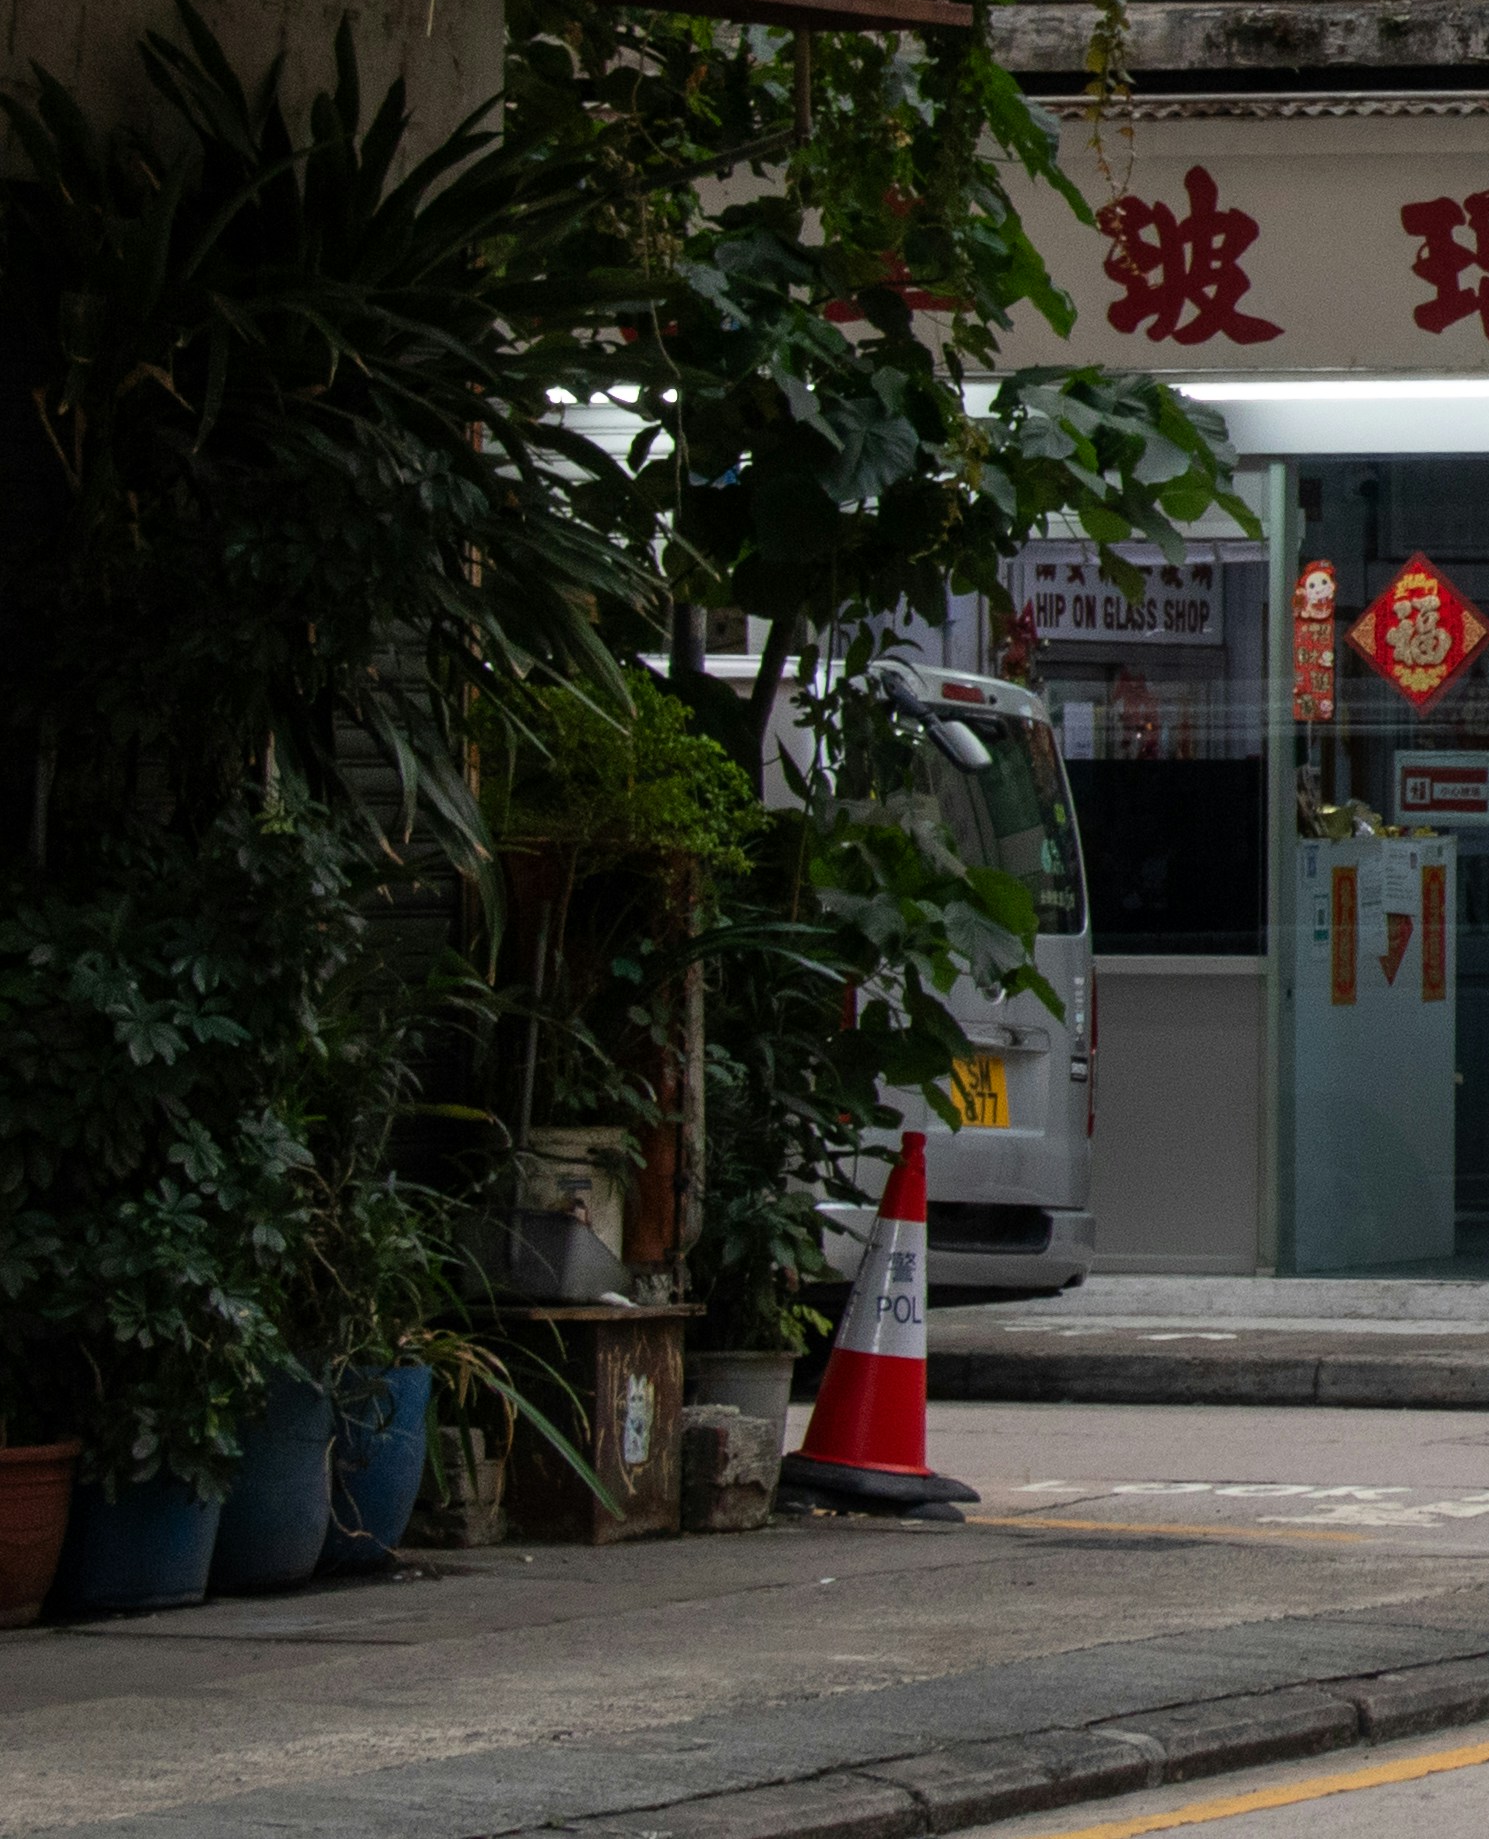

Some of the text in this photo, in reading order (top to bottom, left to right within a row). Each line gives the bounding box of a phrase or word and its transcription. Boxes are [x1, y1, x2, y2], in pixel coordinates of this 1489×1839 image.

[1036, 593, 1066, 628] HIP
[1073, 594, 1097, 629] ON
[1164, 599, 1210, 634] SHOP
